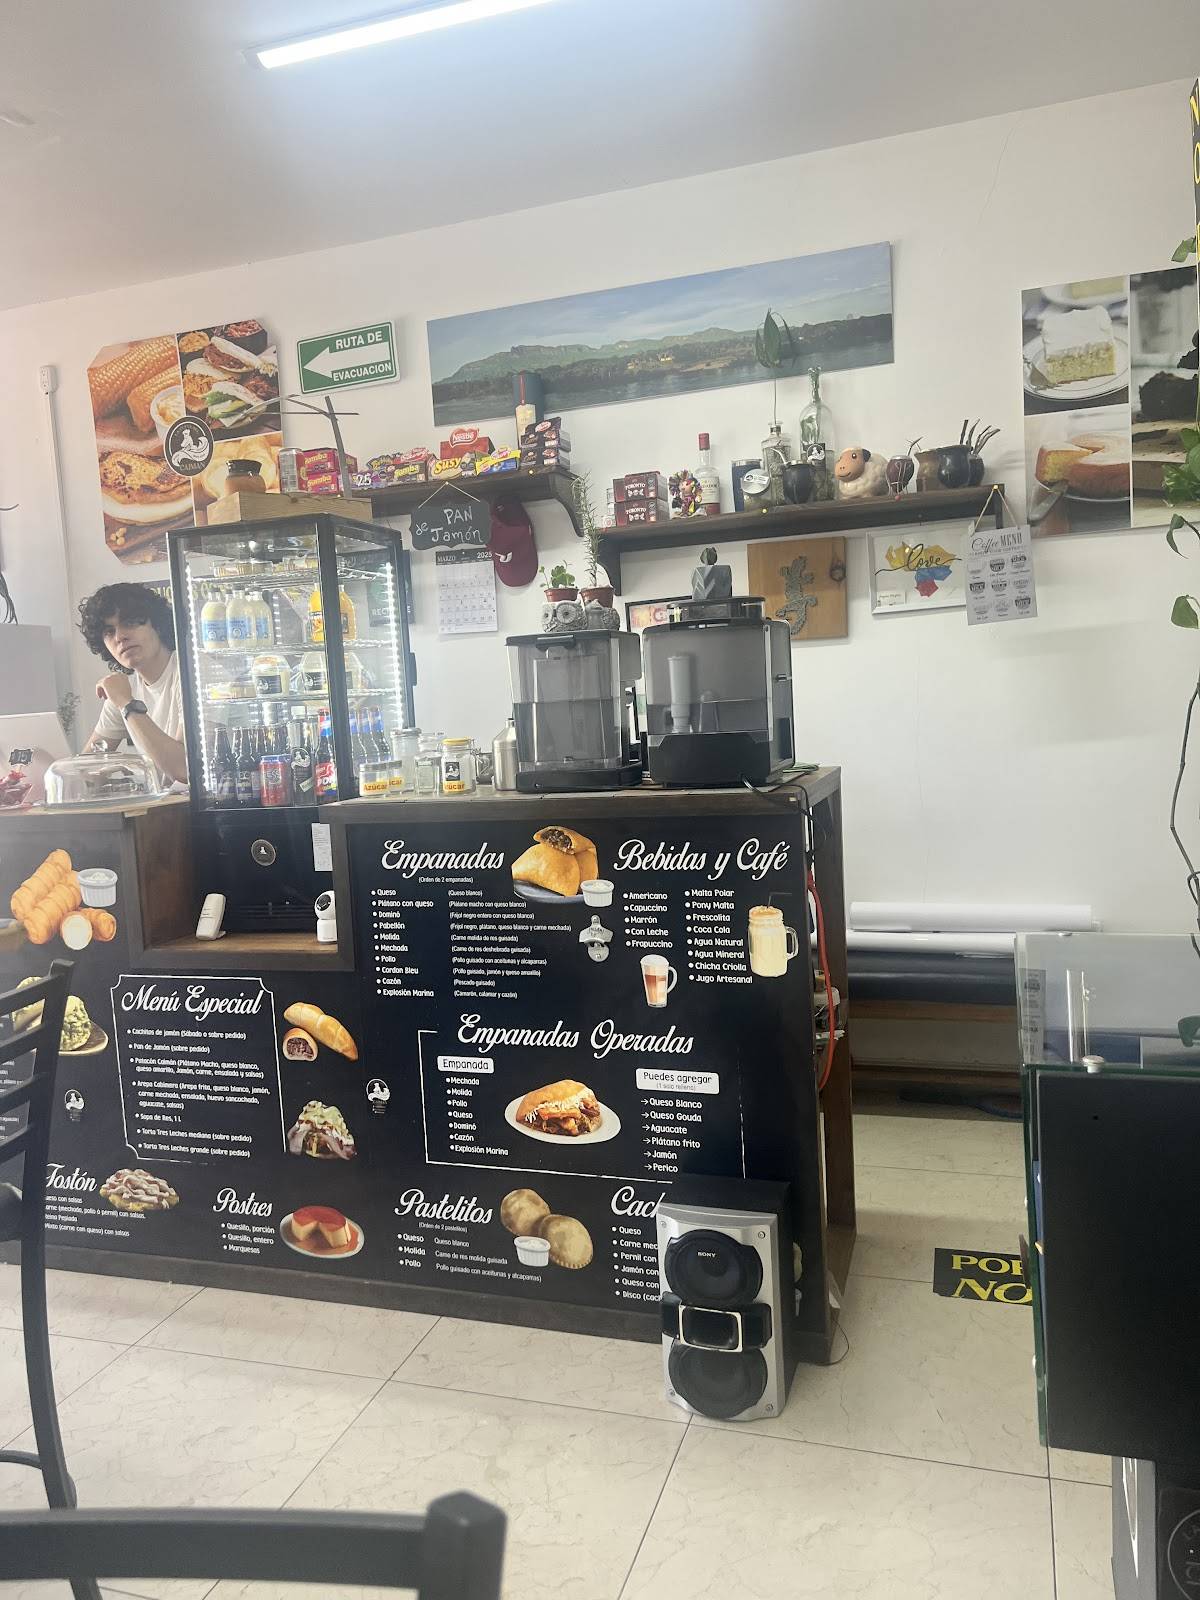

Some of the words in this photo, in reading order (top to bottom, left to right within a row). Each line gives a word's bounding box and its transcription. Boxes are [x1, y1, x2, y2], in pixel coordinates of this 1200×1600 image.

[335, 332, 365, 350] RUTA
[367, 330, 384, 344] DE
[332, 363, 392, 382] EVACUACION
[434, 457, 462, 475] Susy
[625, 482, 646, 490] TORONTO
[443, 506, 473, 525] PAN
[626, 507, 647, 515] TORONTO
[415, 522, 429, 536] de
[430, 526, 484, 543] Jamón
[970, 537, 999, 553] Coffee
[1000, 533, 1022, 547] MENU
[476, 551, 493, 560] 2025
[381, 840, 505, 879] Empanadas
[613, 839, 708, 871] Bebidas
[708, 852, 731, 881] y
[736, 838, 791, 881] Café
[629, 904, 667, 912] Capuccino
[692, 901, 711, 910] Pony
[693, 913, 730, 921] Frescolita
[632, 940, 672, 948] Frapuccino
[694, 938, 713, 946] Agua
[715, 938, 743, 946] Natural
[695, 950, 713, 958] Agua
[715, 950, 744, 958] Mineral
[695, 962, 720, 970] Chicha
[722, 963, 746, 971] Criolla
[696, 975, 714, 983] Jugo
[717, 975, 752, 983] Artesanal
[383, 988, 411, 996] Explosión
[121, 984, 181, 1012] Menú
[184, 985, 264, 1021] Especial
[457, 1013, 580, 1053] Empanadas
[590, 1019, 695, 1059] Operadas
[443, 1059, 488, 1069] Empanada
[451, 1077, 479, 1085] Mechada
[643, 1072, 674, 1081] Puedes
[677, 1075, 711, 1084] agregar
[452, 1088, 472, 1096] Molida
[649, 1097, 673, 1106] Queso
[675, 1099, 702, 1108] Blanco
[453, 1110, 472, 1118] Queso
[650, 1110, 674, 1120] Queso
[676, 1112, 701, 1121] Gouda
[453, 1122, 476, 1130] Dominó
[651, 1124, 687, 1134] Aguacate
[454, 1133, 474, 1141] Cazón
[652, 1137, 680, 1146] Plátano
[682, 1139, 700, 1148] frito
[455, 1144, 484, 1153] Explosión
[486, 1147, 508, 1155] Marina
[652, 1150, 677, 1159] Jamón
[653, 1163, 678, 1172] Perico
[46, 1163, 97, 1192] Tostón
[212, 1187, 273, 1217] Postres
[395, 1188, 493, 1224] Pastelitos
[227, 1222, 251, 1232] Quesillo,
[619, 1226, 641, 1235] Queso
[227, 1233, 252, 1242] Quesillo,
[403, 1233, 424, 1242] Queso
[434, 1237, 451, 1245] Queso
[452, 1239, 469, 1247] blanco
[620, 1239, 641, 1248] Carne
[229, 1244, 260, 1253] Marquesas
[404, 1246, 425, 1255] Molida
[621, 1252, 641, 1261] Pernil
[405, 1259, 421, 1267] Pollo
[621, 1265, 644, 1274] Jamón
[646, 1267, 659, 1277] con
[622, 1278, 644, 1286] Queso
[623, 1291, 641, 1299] Disco
